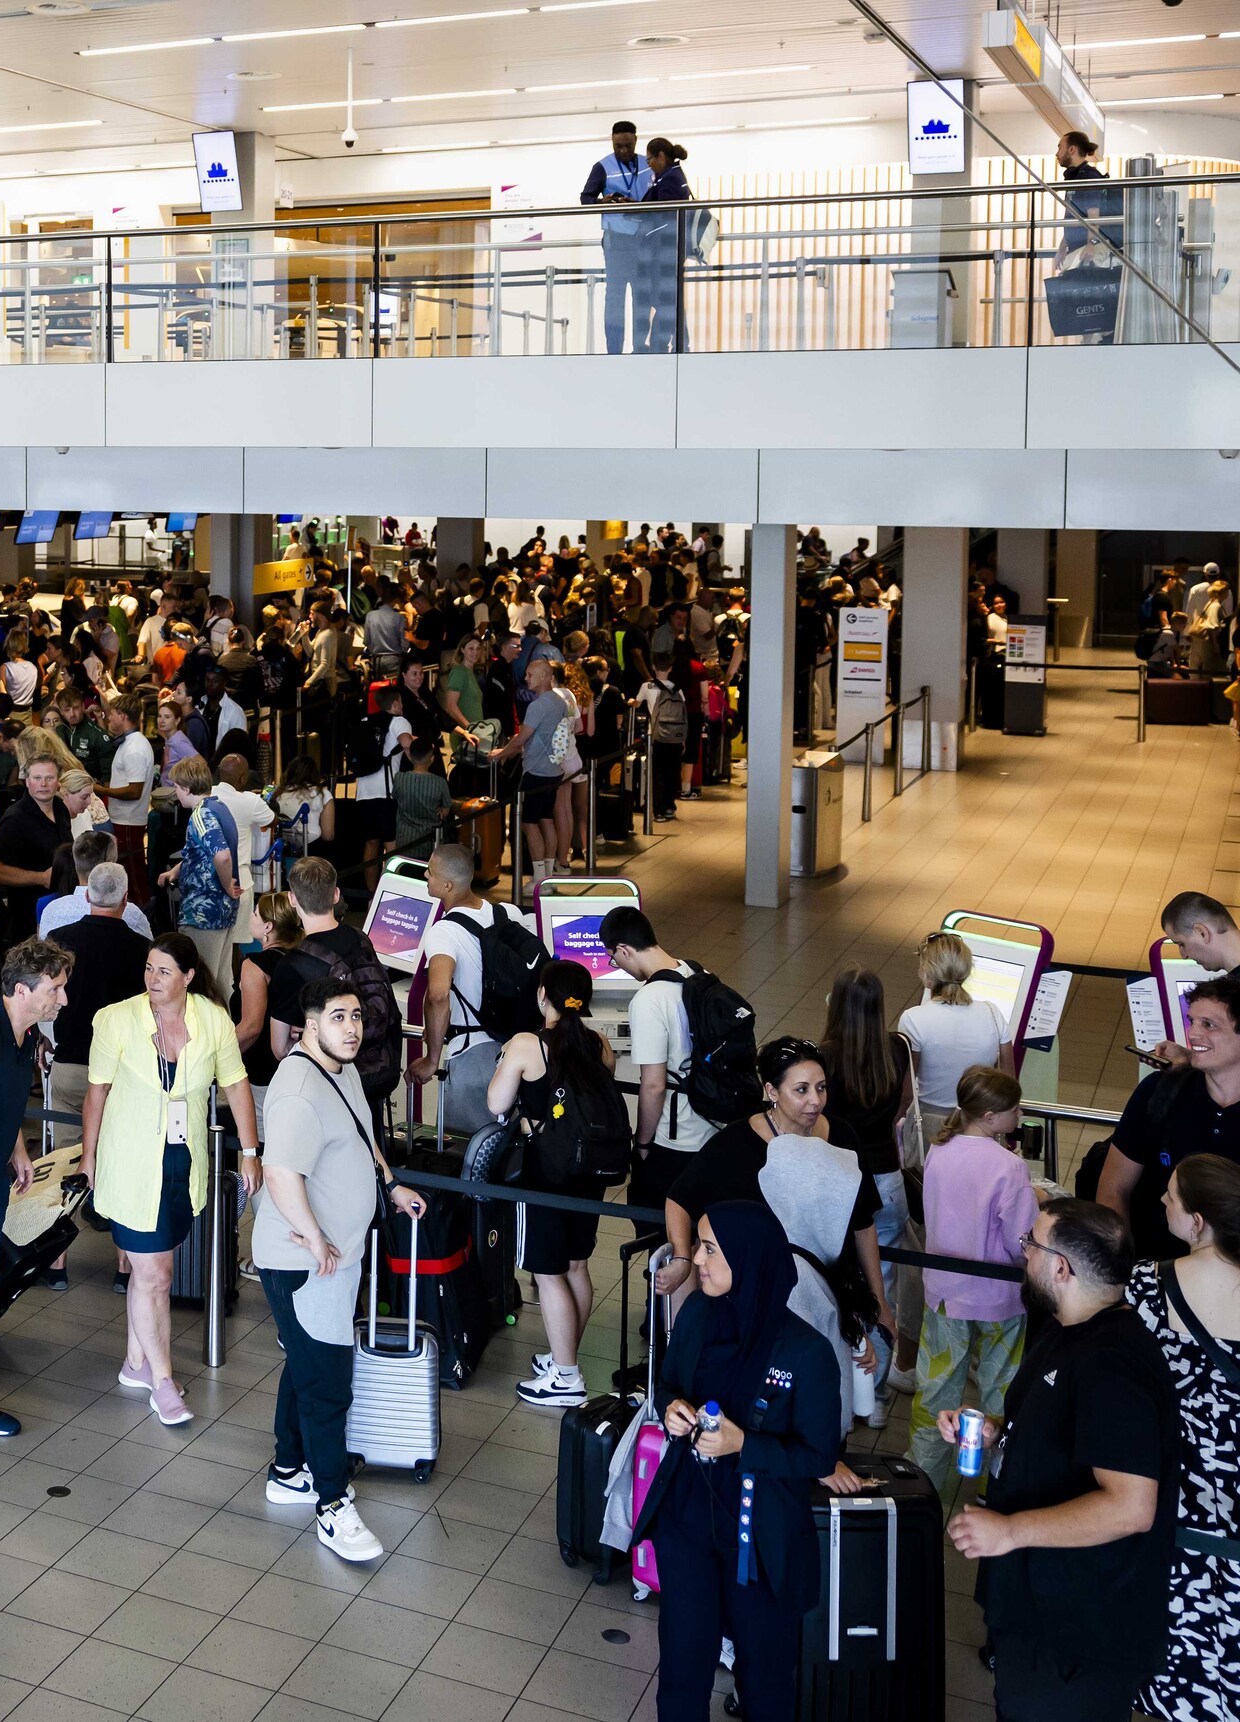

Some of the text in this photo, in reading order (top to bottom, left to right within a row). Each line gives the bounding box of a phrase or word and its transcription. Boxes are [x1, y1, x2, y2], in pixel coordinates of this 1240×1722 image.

[1076, 304, 1105, 315] GENTS
[282, 571, 296, 582] gates
[387, 908, 396, 916] Self
[396, 911, 414, 921] check-in
[381, 914, 400, 926] baggage
[401, 920, 419, 932] tagging
[564, 940, 594, 948] baggage
